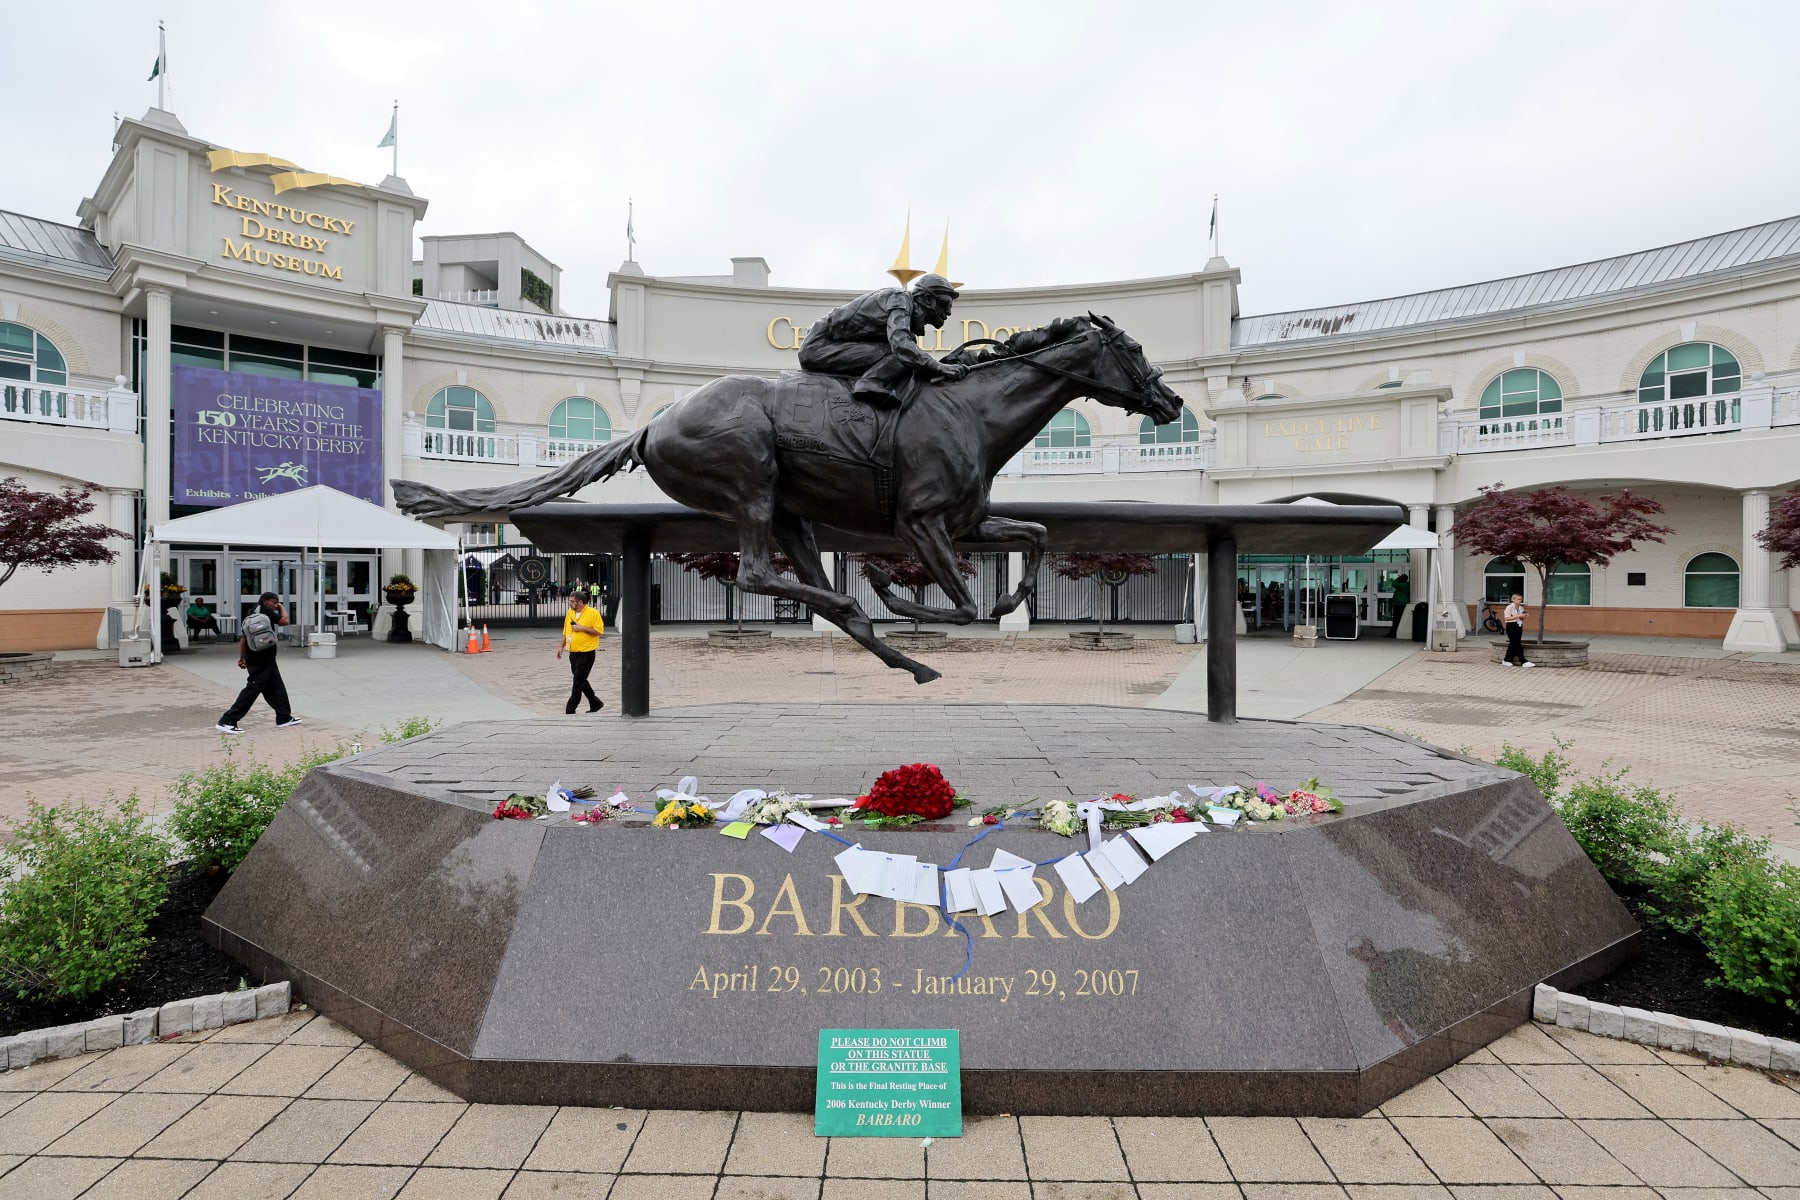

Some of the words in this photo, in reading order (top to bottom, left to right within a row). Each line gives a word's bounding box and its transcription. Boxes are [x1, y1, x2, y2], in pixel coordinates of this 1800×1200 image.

[212, 182, 355, 235] KENTUCKY
[240, 215, 328, 254] DERBY
[222, 237, 343, 280] MUSEUM
[216, 394, 344, 420] CELEBRATING
[195, 410, 236, 427] 150
[240, 413, 300, 433] YEARS
[303, 420, 328, 435] OF
[330, 422, 363, 438] THE
[1264, 415, 1384, 438] EXECUTIVE
[198, 427, 303, 450] KENTUCKY
[306, 437, 364, 455] DERBY
[1295, 435, 1349, 452] GATE
[185, 488, 231, 499] Exhibits
[689, 964, 758, 996] April
[766, 967, 807, 997] 29,
[816, 966, 882, 994] 2003
[911, 968, 1015, 1003] January
[1024, 969, 1066, 1000] 29,
[1074, 969, 1139, 996] 2007
[831, 1037, 869, 1047] PLEASE
[872, 1037, 887, 1047] DO
[889, 1037, 911, 1047] NOT
[913, 1037, 947, 1047] CLIMB
[848, 1050, 863, 1059] ON
[865, 1050, 889, 1059] THIS
[891, 1050, 930, 1059] STATUE
[830, 1062, 846, 1071] OR
[848, 1062, 869, 1071] THE
[872, 1062, 919, 1071] GRANITE
[921, 1062, 947, 1071] BASE
[831, 1082, 846, 1090] This
[848, 1082, 854, 1090] is
[856, 1082, 867, 1090] the
[869, 1082, 887, 1090] Final
[889, 1082, 917, 1091] Resting
[918, 1082, 937, 1090] Place
[938, 1082, 947, 1090] of
[826, 1100, 846, 1109] 2006
[848, 1100, 888, 1110] Kentucky
[891, 1100, 917, 1110] Derby
[919, 1100, 951, 1109] Winner
[856, 1113, 922, 1126] BARBARO
